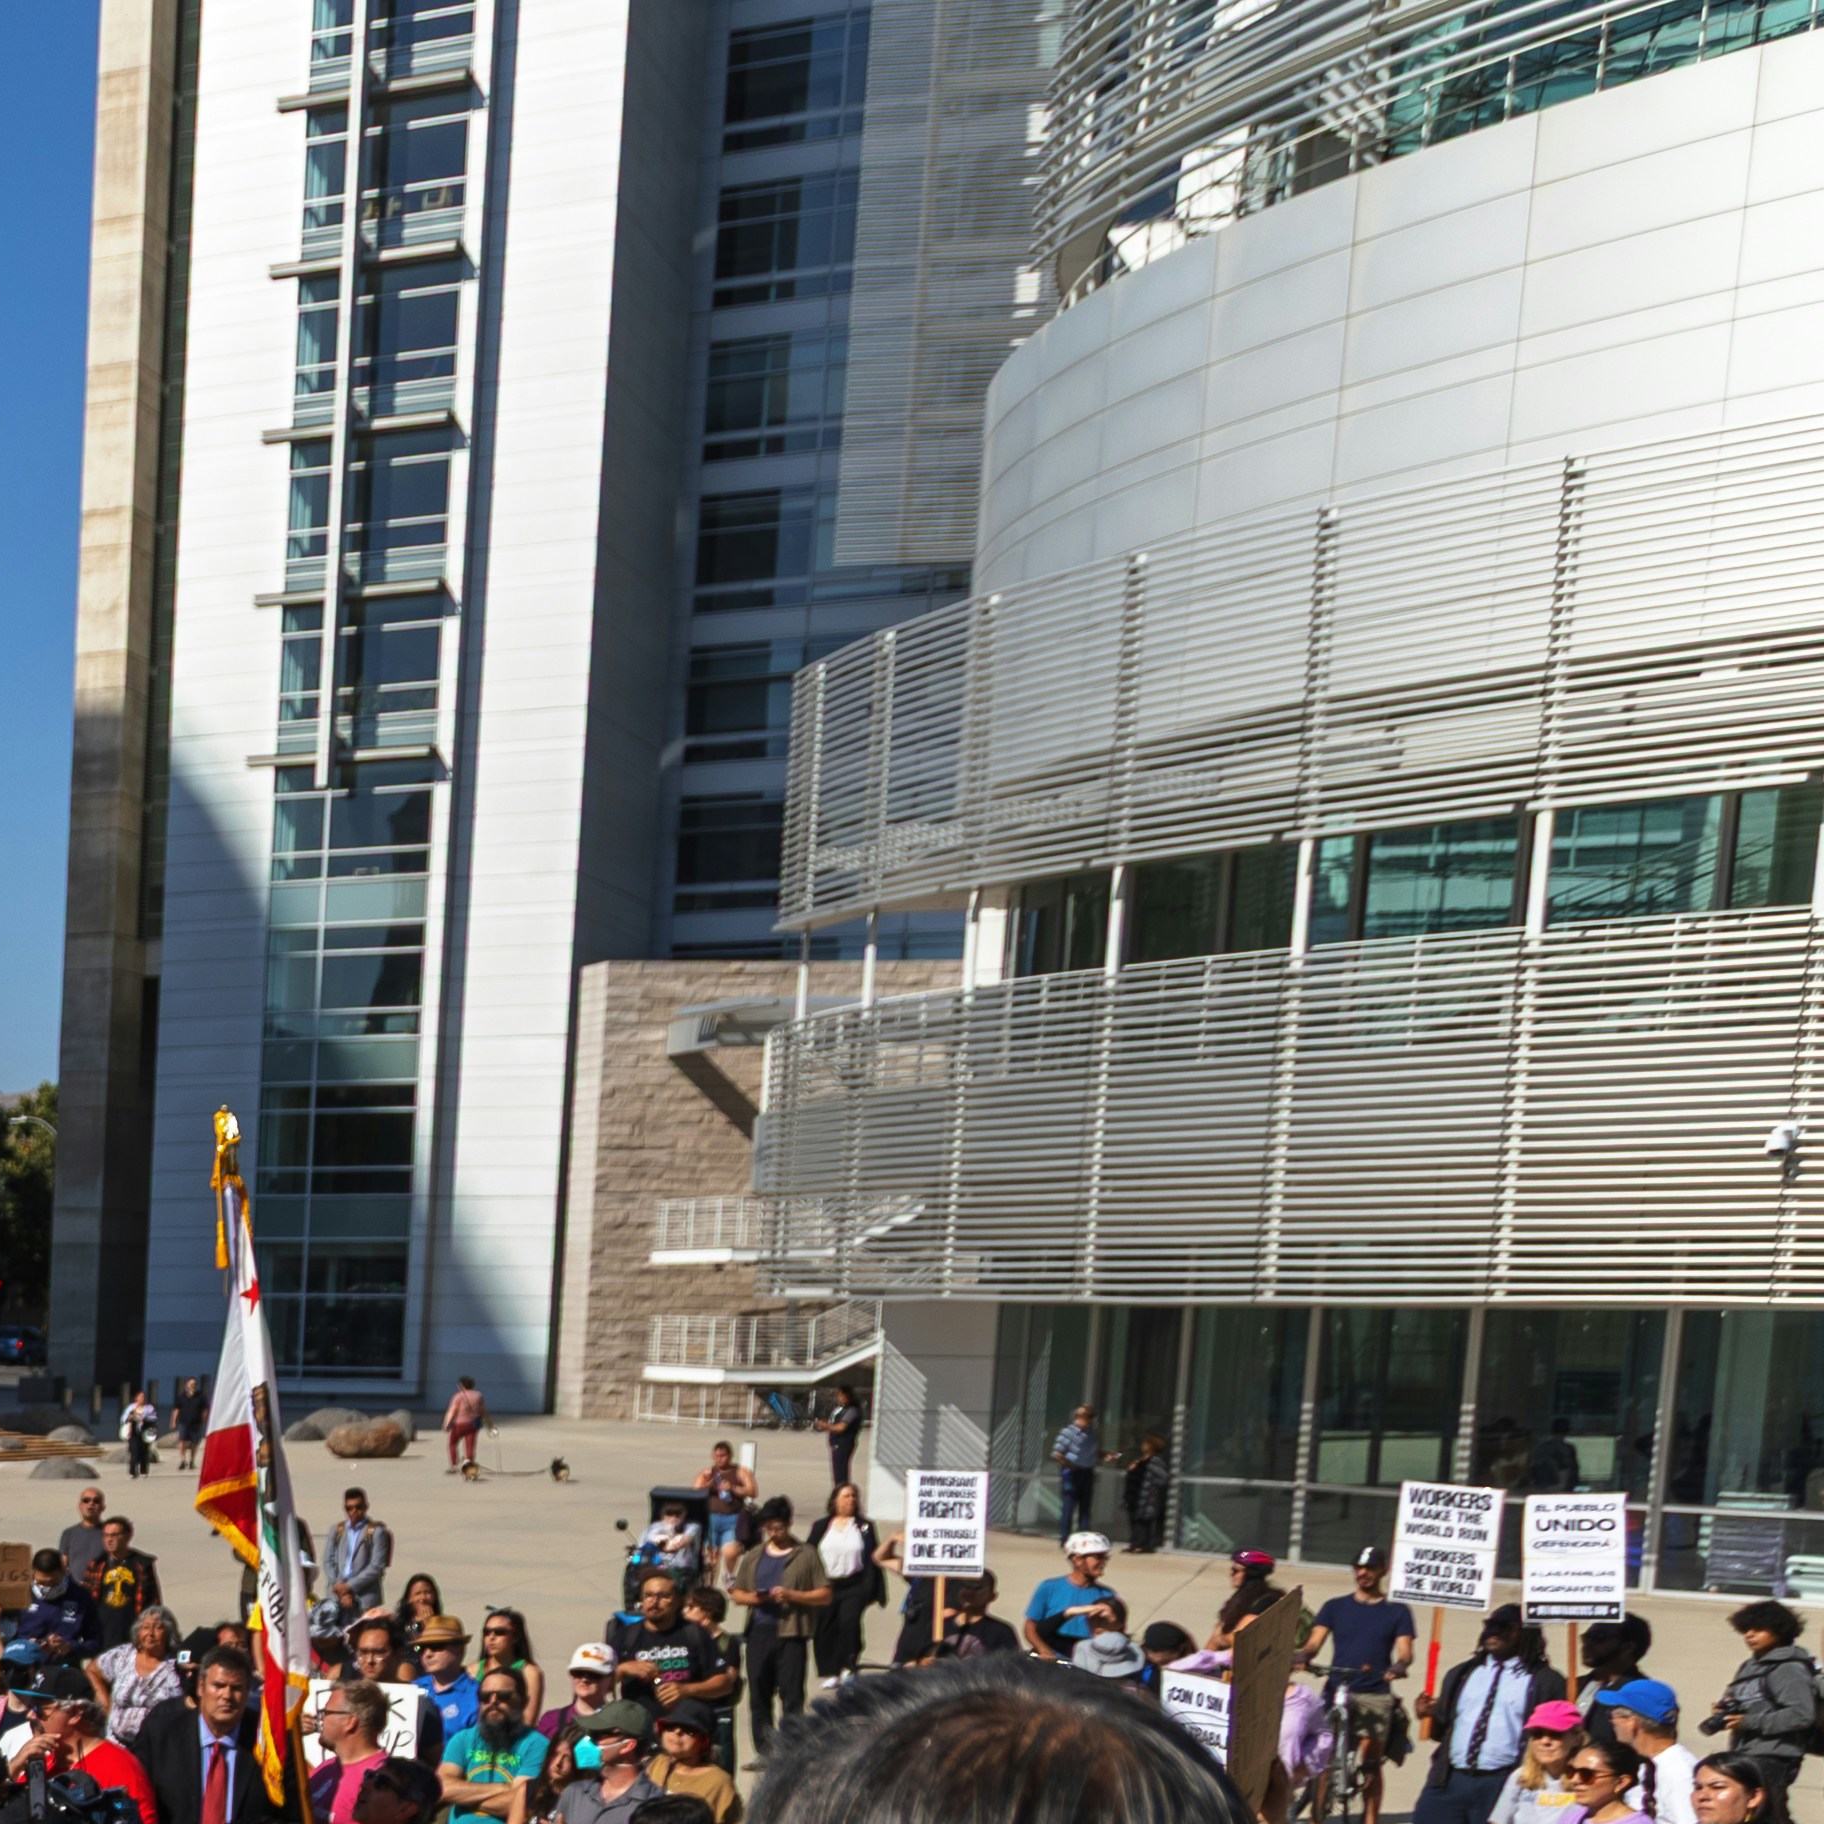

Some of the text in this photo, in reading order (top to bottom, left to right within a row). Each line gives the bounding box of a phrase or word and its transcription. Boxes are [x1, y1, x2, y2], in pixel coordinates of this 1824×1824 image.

[1409, 1486, 1493, 1513] WORKERS
[1534, 1502, 1617, 1514] EL PUEBLO
[918, 1499, 976, 1520] RIGHTS
[1412, 1507, 1484, 1526] MAKE THE
[912, 1528, 978, 1540] ONE STRUGGLE
[1404, 1522, 1490, 1542] WORLD RUN
[1535, 1518, 1617, 1532] UNIDO
[911, 1543, 978, 1559] ONE FIGHT
[1413, 1547, 1478, 1566] WORKERS
[1404, 1561, 1484, 1581] SHOULD RUN
[1404, 1578, 1476, 1596] THE WORLD
[635, 1645, 689, 1662] adidas
[1196, 1691, 1204, 1708] O
